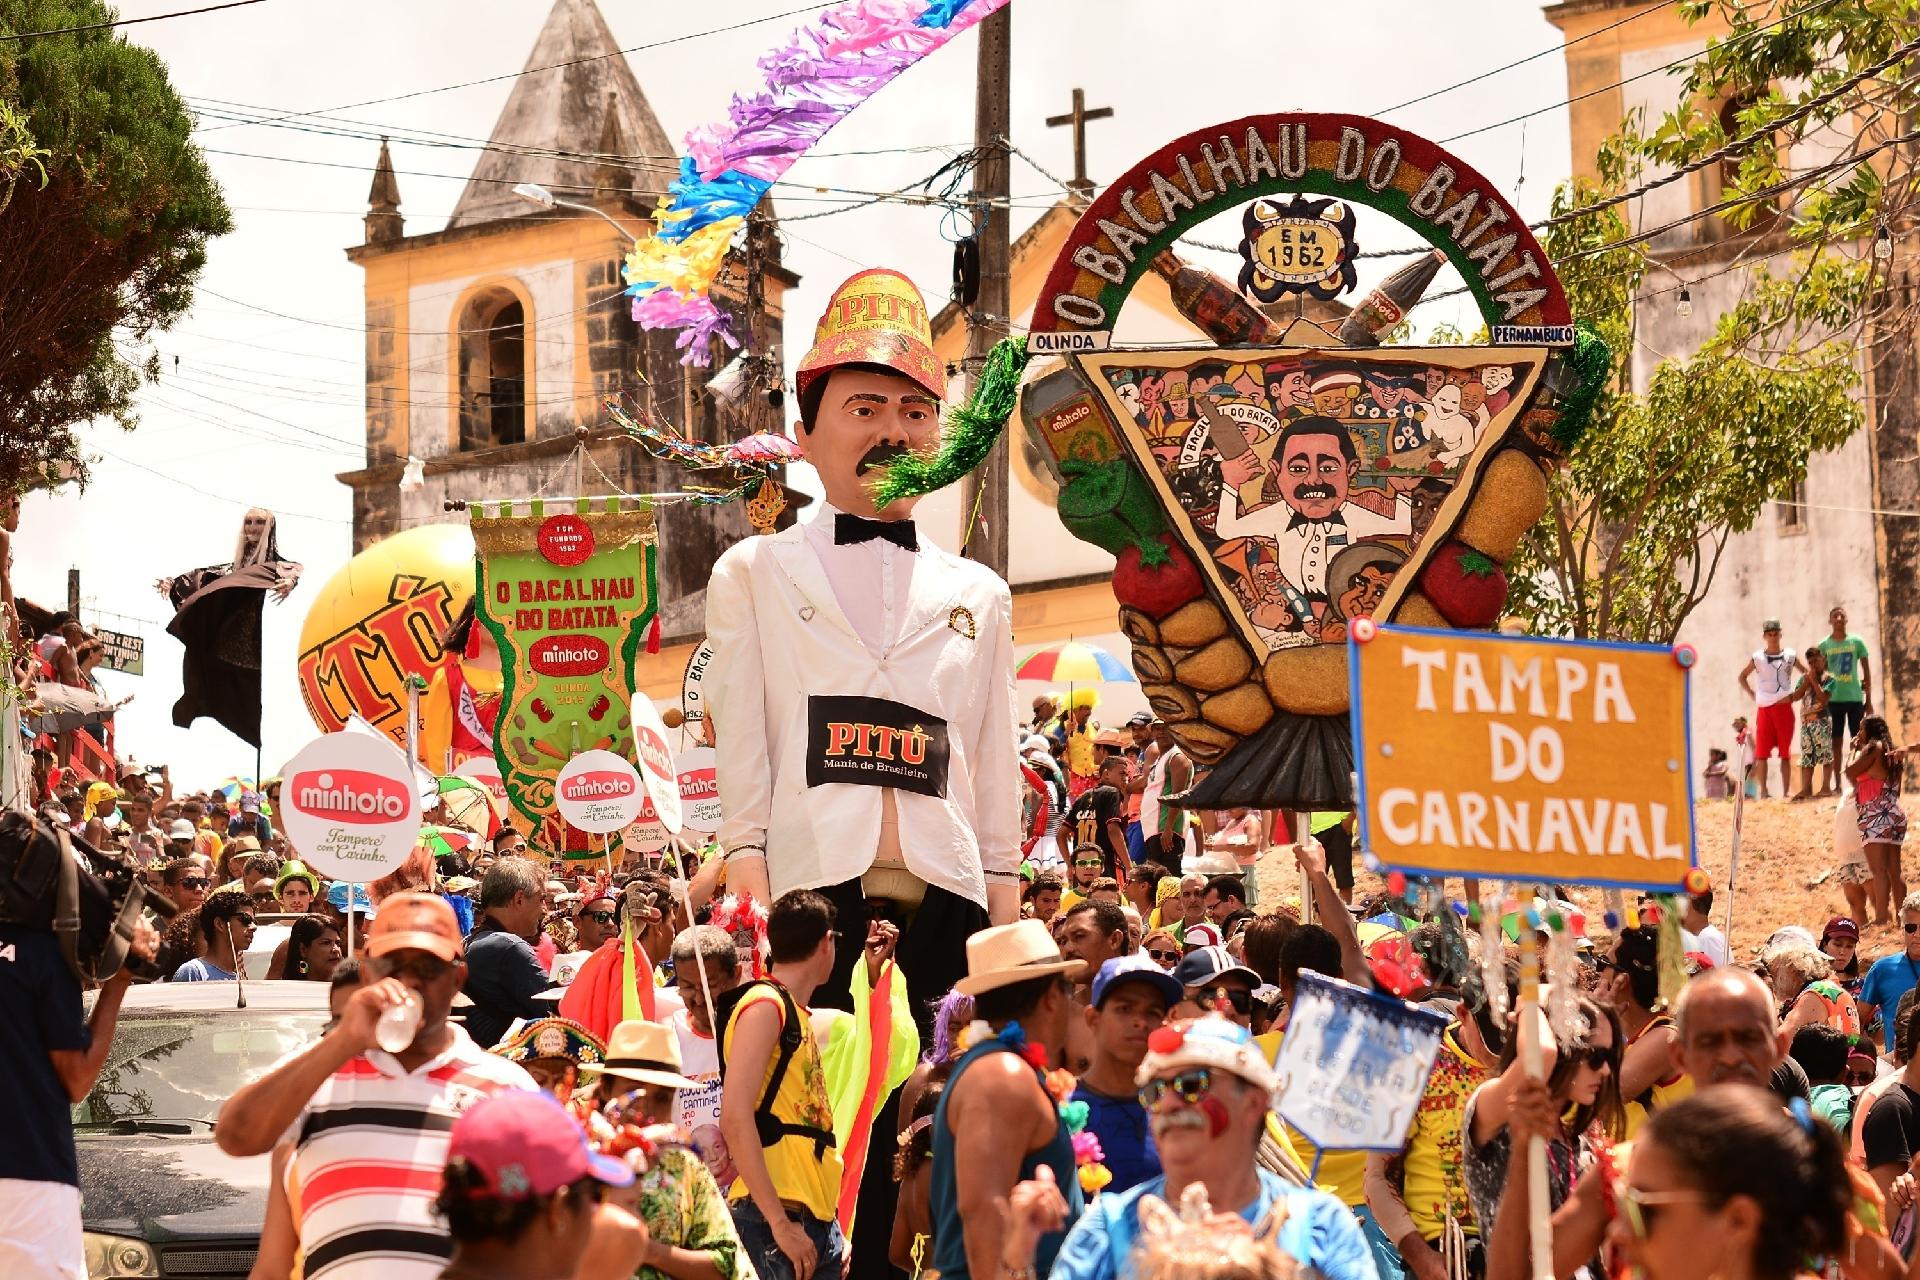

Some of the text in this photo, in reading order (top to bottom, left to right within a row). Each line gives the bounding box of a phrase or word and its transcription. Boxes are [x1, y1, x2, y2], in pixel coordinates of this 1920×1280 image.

[1054, 123, 1548, 327] O BACALHAU DO BATATA
[1281, 229, 1317, 244] EM
[1267, 246, 1325, 266] 1962
[836, 293, 927, 336] PITÚ
[1036, 334, 1095, 349] OLINDA
[1494, 326, 1573, 343] PERNAMBUCO
[1052, 406, 1090, 431] minhoto
[1231, 408, 1244, 417] DO
[1247, 409, 1278, 432] BATATA
[549, 534, 583, 543] FUNDADO
[496, 577, 635, 603] O BACALHAU
[516, 605, 619, 631] DO BATATA
[97, 630, 115, 644] BAR
[298, 574, 453, 734] ITÚ
[542, 645, 599, 663] minhoto
[554, 683, 591, 692] OLINDA
[1401, 646, 1637, 723] TAMPA
[688, 691, 699, 700] O
[826, 723, 929, 764] PITÚ
[1489, 721, 1564, 784] DO
[824, 760, 928, 779] Mania de Brasileiro
[300, 773, 404, 818] minhoto
[568, 776, 631, 798] minhoto
[1378, 788, 1684, 860] CARNAVAL
[316, 844, 335, 852] com
[326, 828, 385, 849] Tempere
[683, 1095, 717, 1110] CANTINHO
